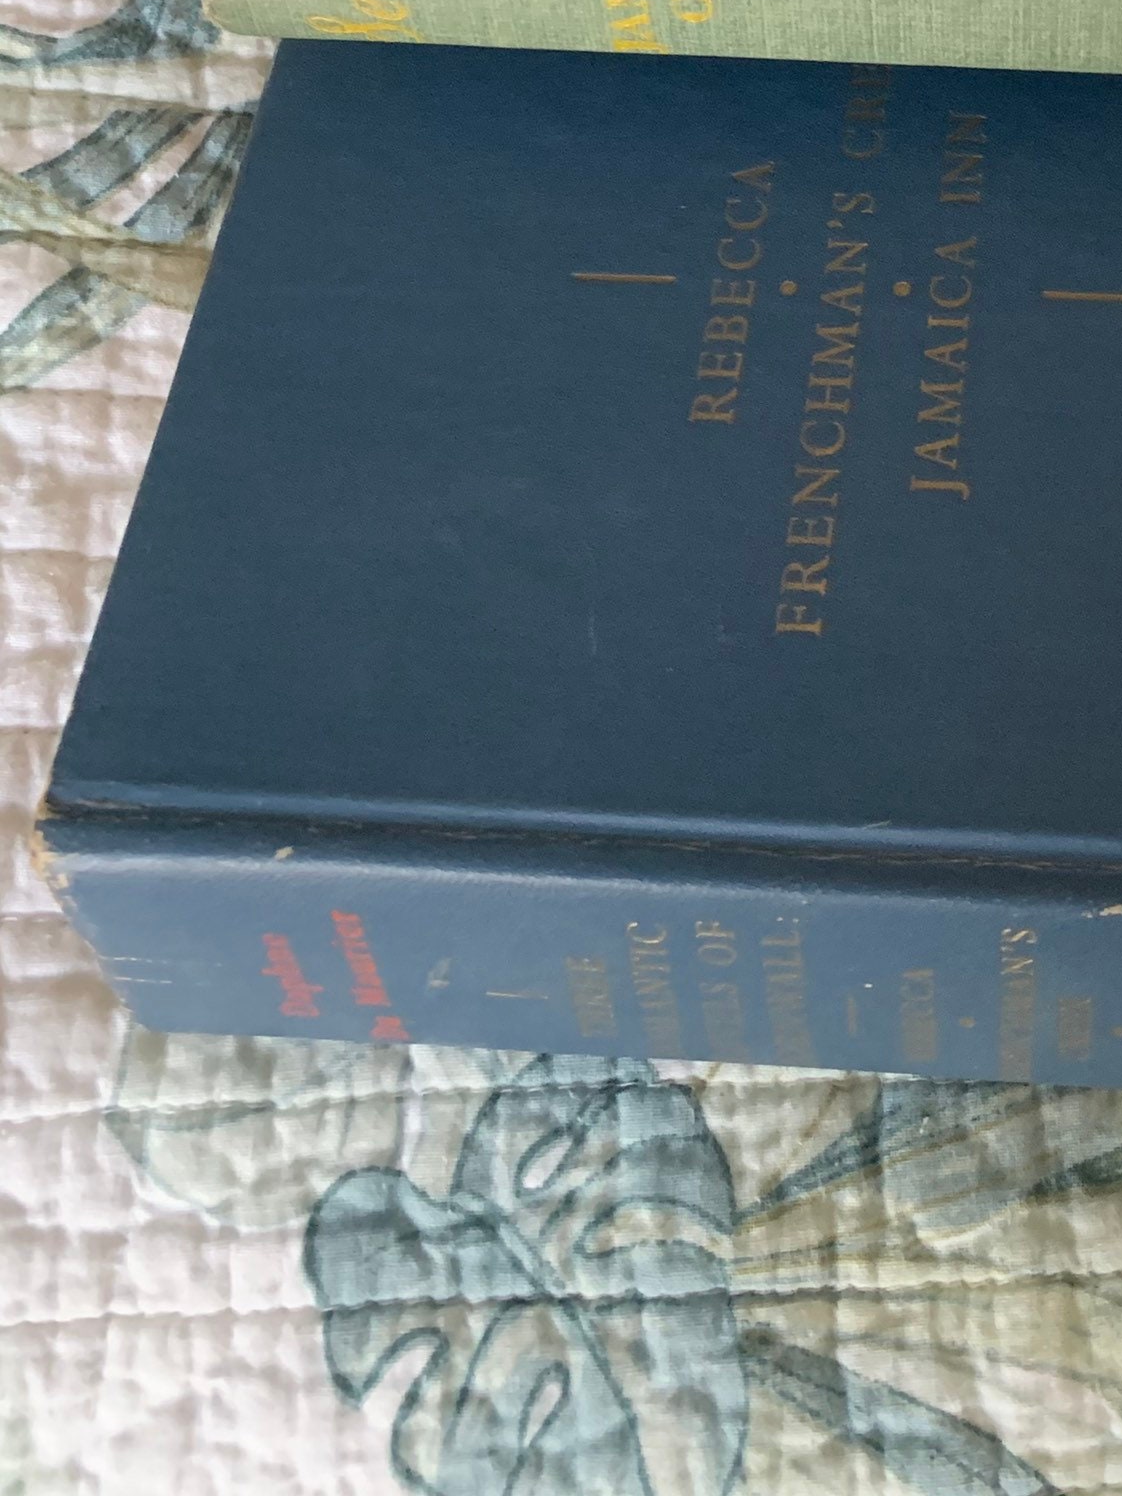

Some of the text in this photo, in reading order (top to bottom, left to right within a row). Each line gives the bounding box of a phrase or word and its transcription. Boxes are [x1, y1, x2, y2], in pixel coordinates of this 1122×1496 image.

[687, 160, 777, 425] REBECCA
[775, 191, 877, 636] FRENCHMAN'S
[909, 109, 989, 501] JAMAICA INN
[695, 920, 738, 967] OF
